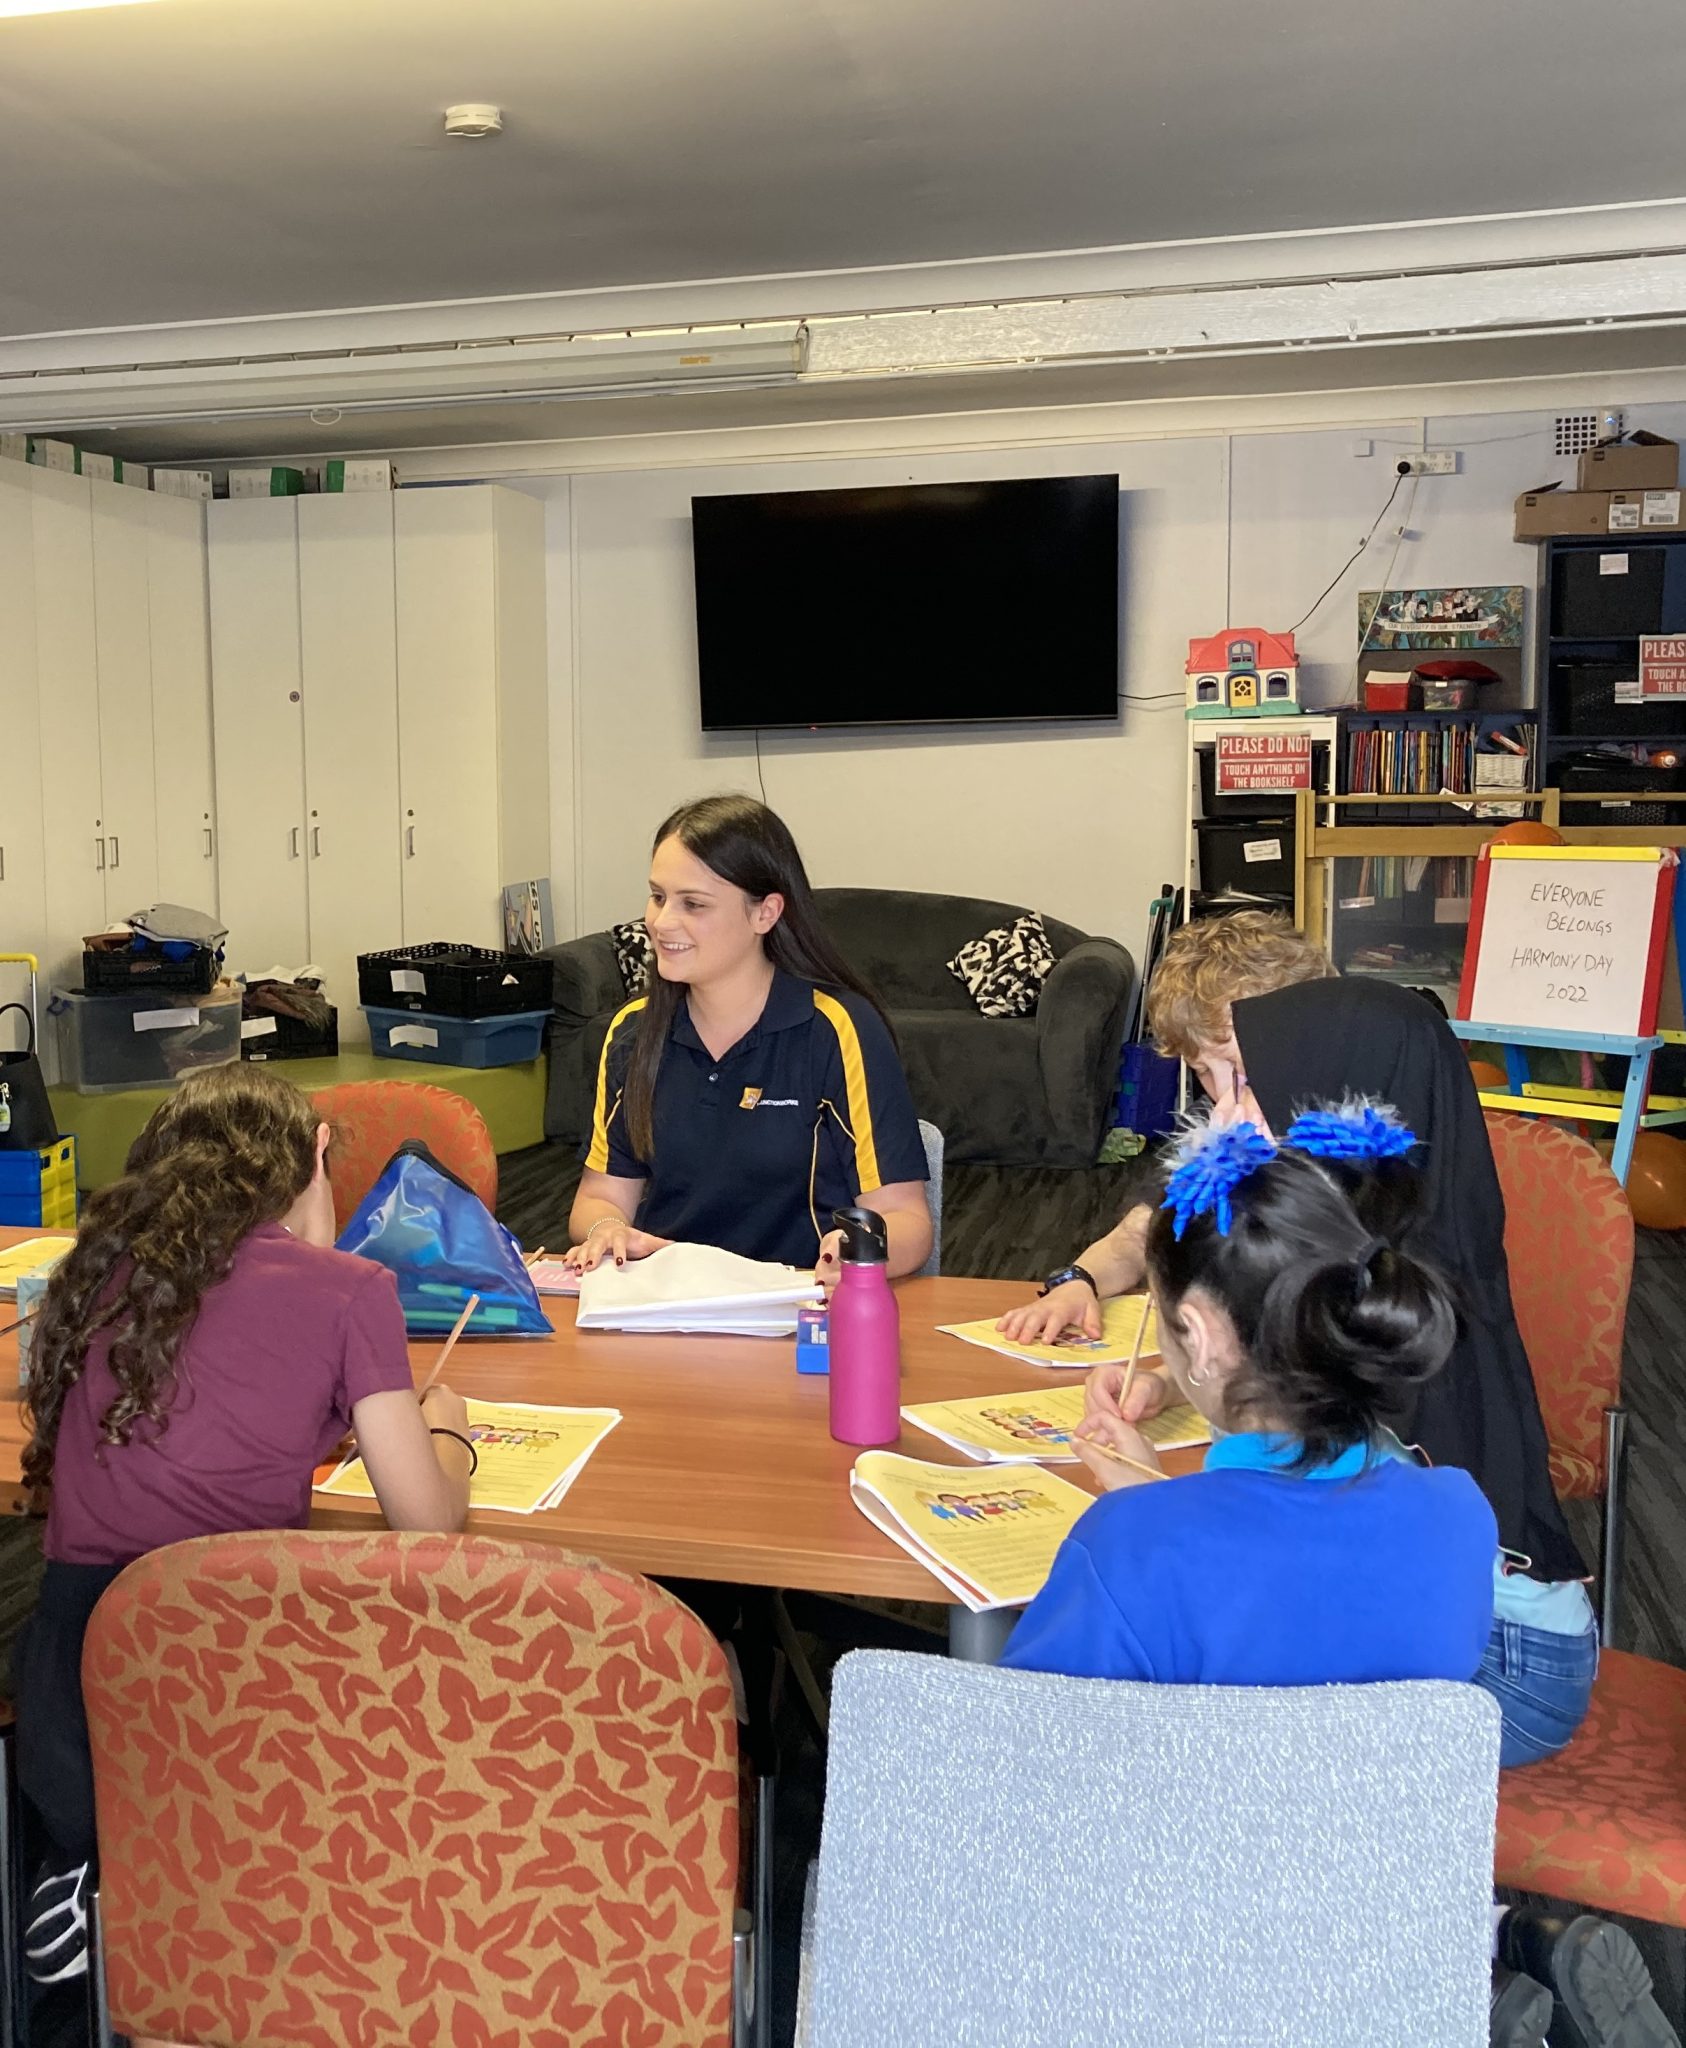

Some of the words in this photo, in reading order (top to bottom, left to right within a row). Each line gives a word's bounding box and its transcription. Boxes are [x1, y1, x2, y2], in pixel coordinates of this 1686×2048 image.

[1644, 641, 1686, 658] PLEAS
[1648, 668, 1677, 680] TOUCH
[1657, 681, 1675, 693] THE
[1221, 737, 1264, 754] PLEASE
[1267, 737, 1284, 754] DO
[1287, 736, 1310, 753] NOT
[1225, 764, 1250, 776] TOUCH
[1252, 763, 1293, 775] ANYTHING
[1294, 763, 1305, 775] ON
[1233, 777, 1249, 788] THE
[1250, 776, 1296, 788] BOOKSHELF
[1530, 882, 1606, 908] EVERYONE
[1546, 911, 1612, 936] BELONGS
[1511, 946, 1582, 971] HARMONY
[1584, 954, 1614, 976] DAY
[1546, 983, 1589, 1003] 2022
